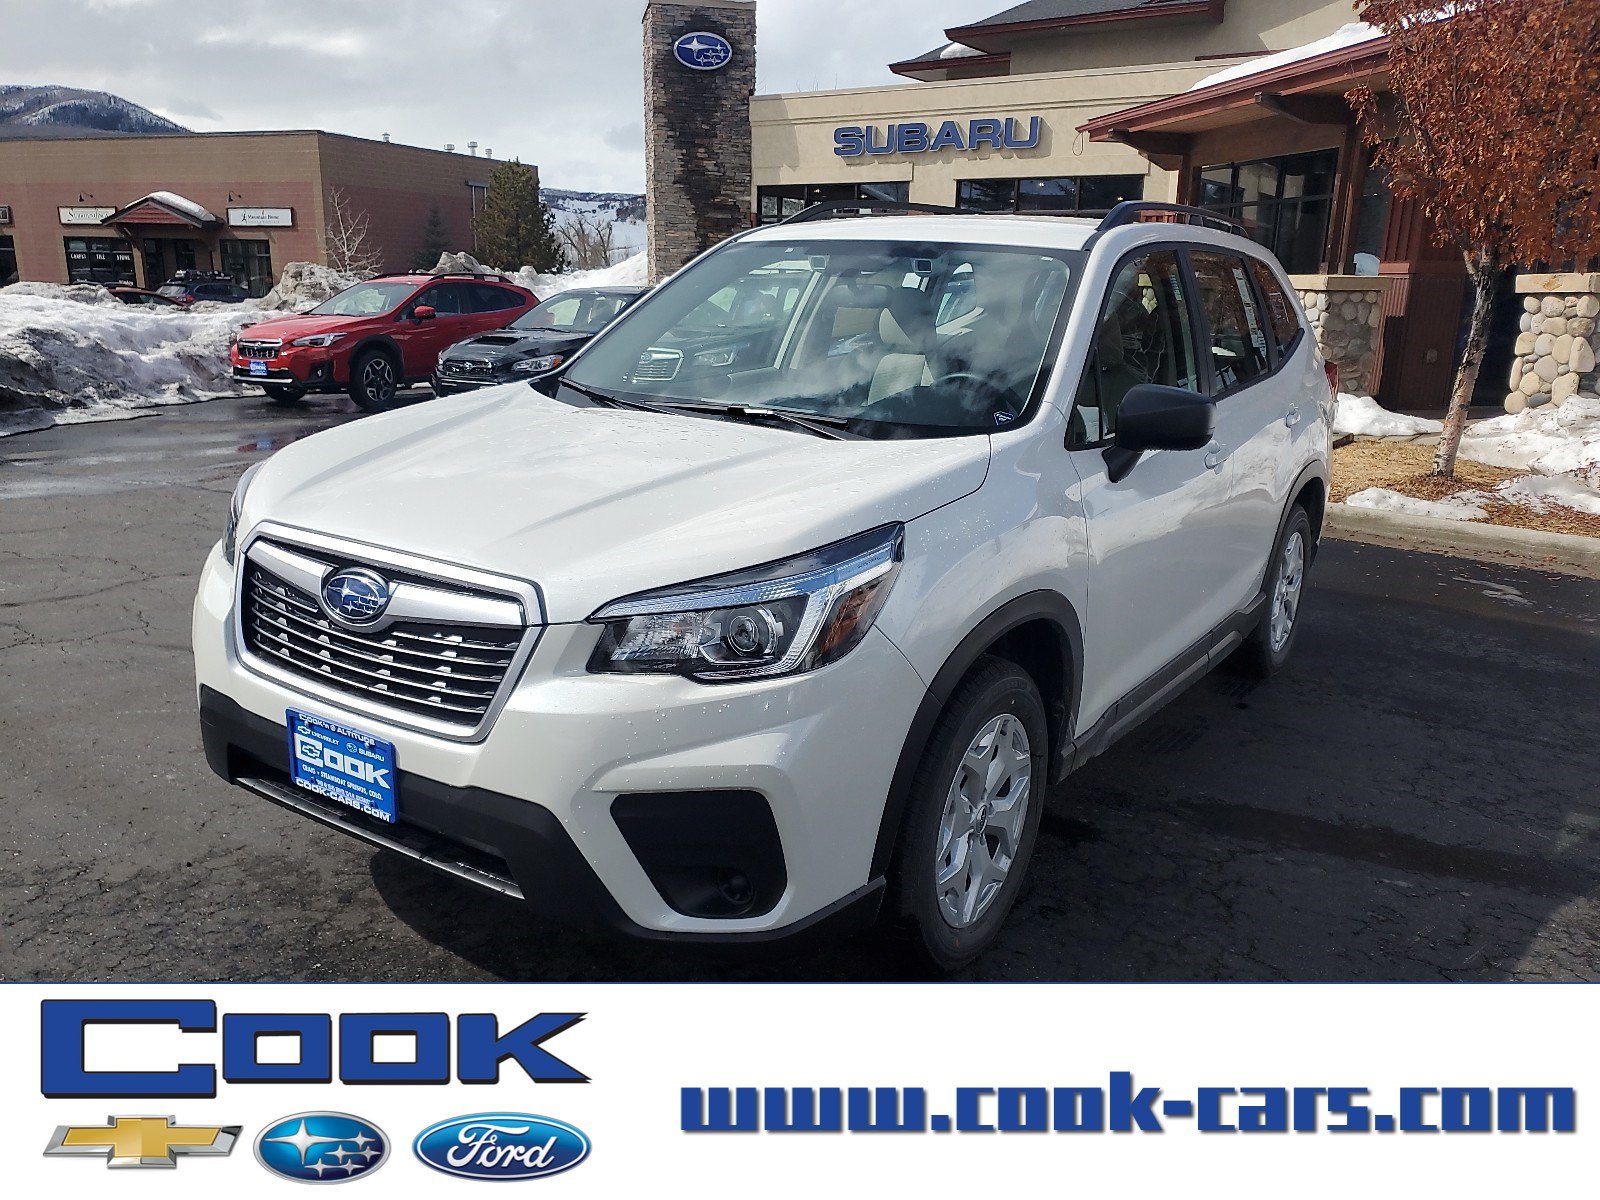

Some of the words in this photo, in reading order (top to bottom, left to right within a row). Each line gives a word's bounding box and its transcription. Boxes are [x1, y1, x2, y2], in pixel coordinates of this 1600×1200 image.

[833, 115, 1040, 156] SUBARU
[311, 730, 340, 746] CHEVROLET
[358, 747, 385, 762] SUBARU
[336, 727, 376, 746] ALTITUDE
[294, 732, 391, 790] COOK
